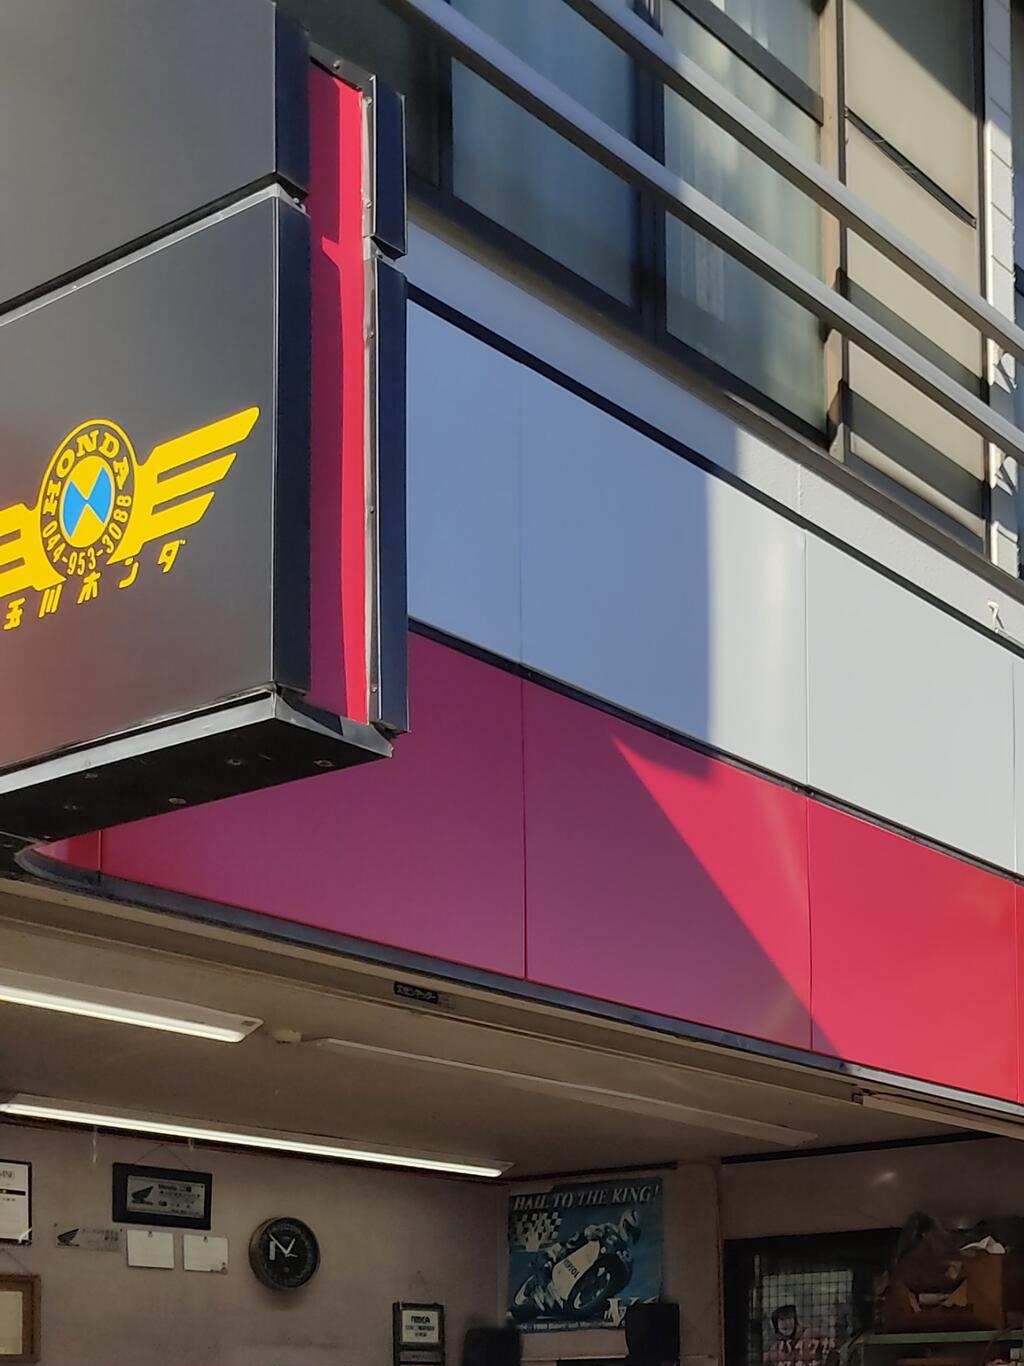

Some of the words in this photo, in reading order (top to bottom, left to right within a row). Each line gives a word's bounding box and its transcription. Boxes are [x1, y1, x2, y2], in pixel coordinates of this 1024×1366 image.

[43, 429, 130, 515] HONDA
[43, 494, 132, 576] 044-953-3088
[3, 538, 187, 630] 玉川ホンダ
[551, 1191, 574, 1209] TO
[575, 1188, 608, 1207] THE
[612, 1183, 661, 1204] KING!
